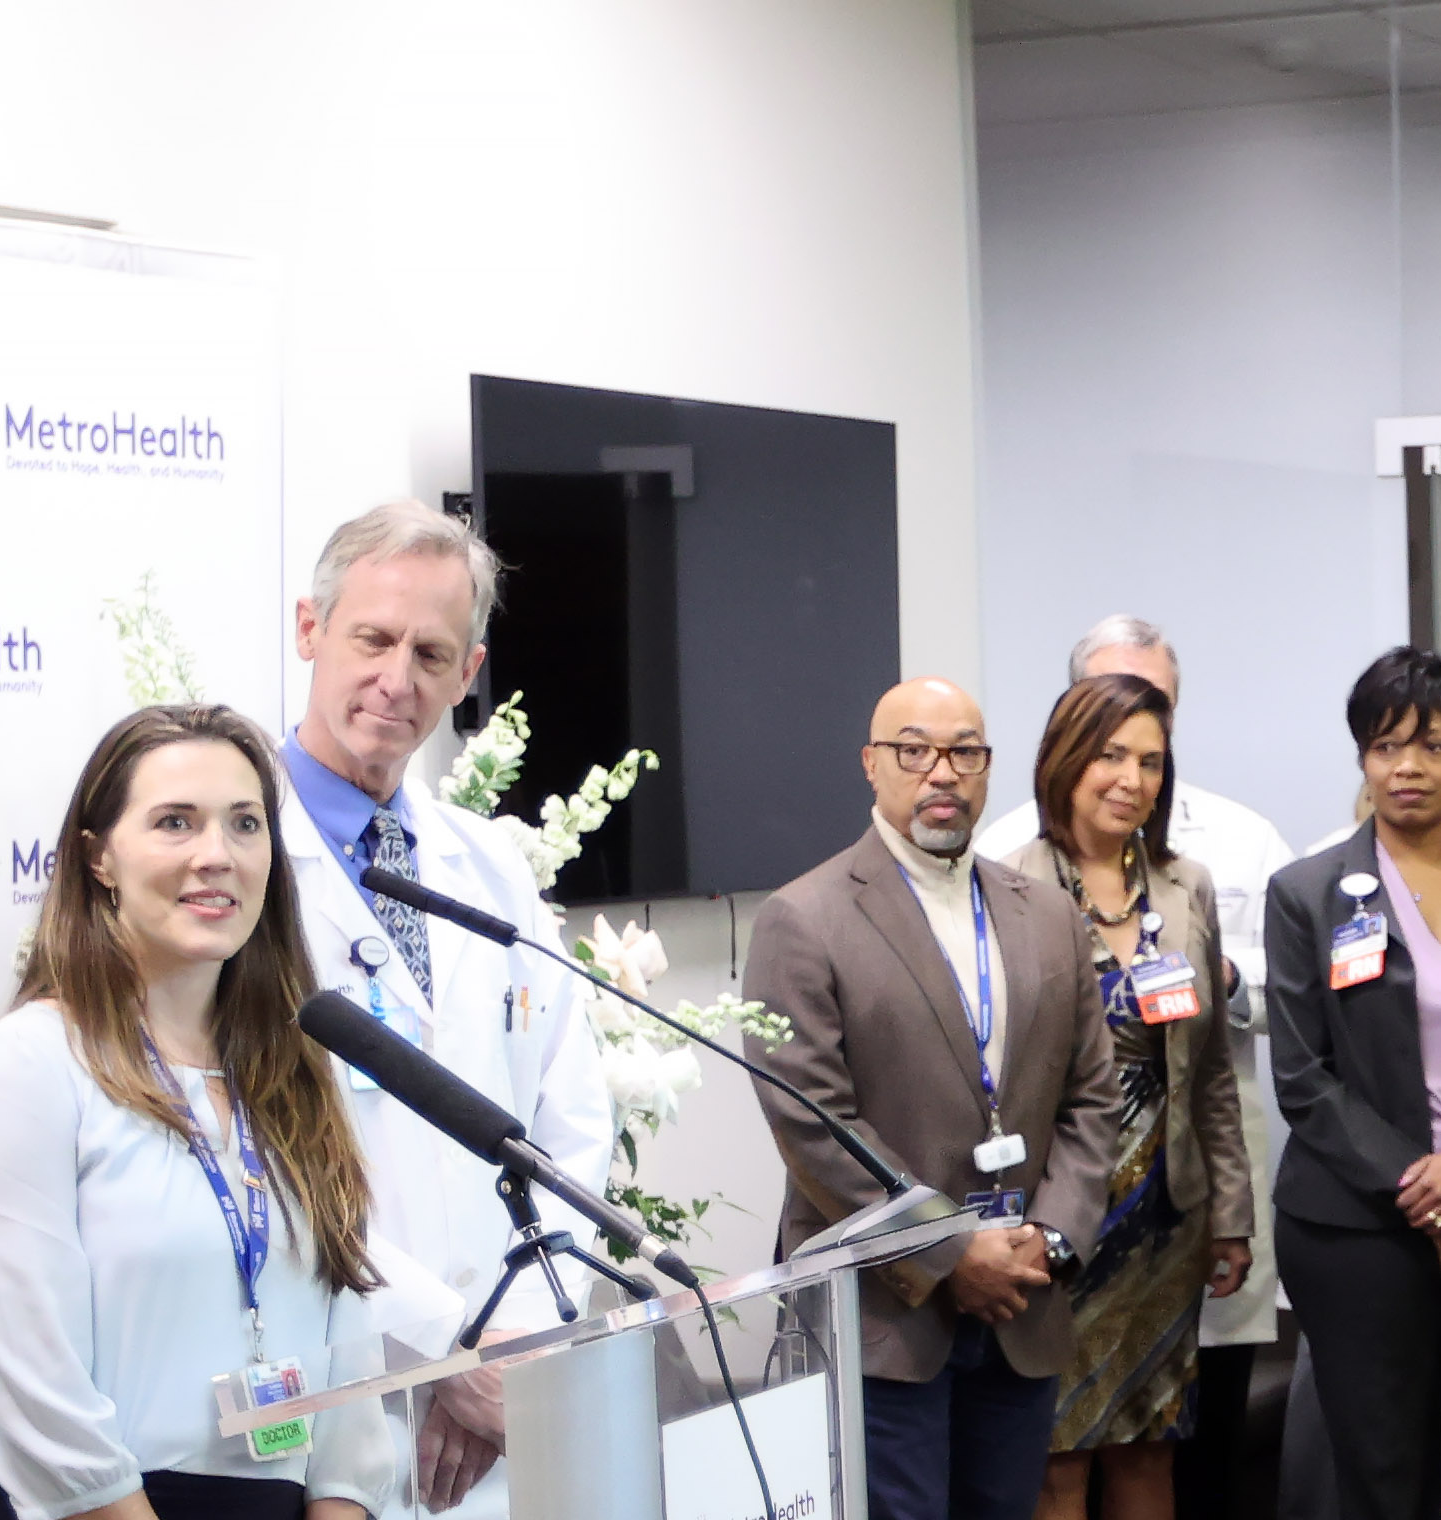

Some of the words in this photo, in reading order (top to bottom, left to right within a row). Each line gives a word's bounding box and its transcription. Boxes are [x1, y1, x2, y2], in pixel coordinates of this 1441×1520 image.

[5, 403, 224, 460] MetroHealth
[1349, 953, 1381, 981] RN
[1157, 990, 1195, 1018] RN
[260, 1422, 302, 1446] DOCTOR
